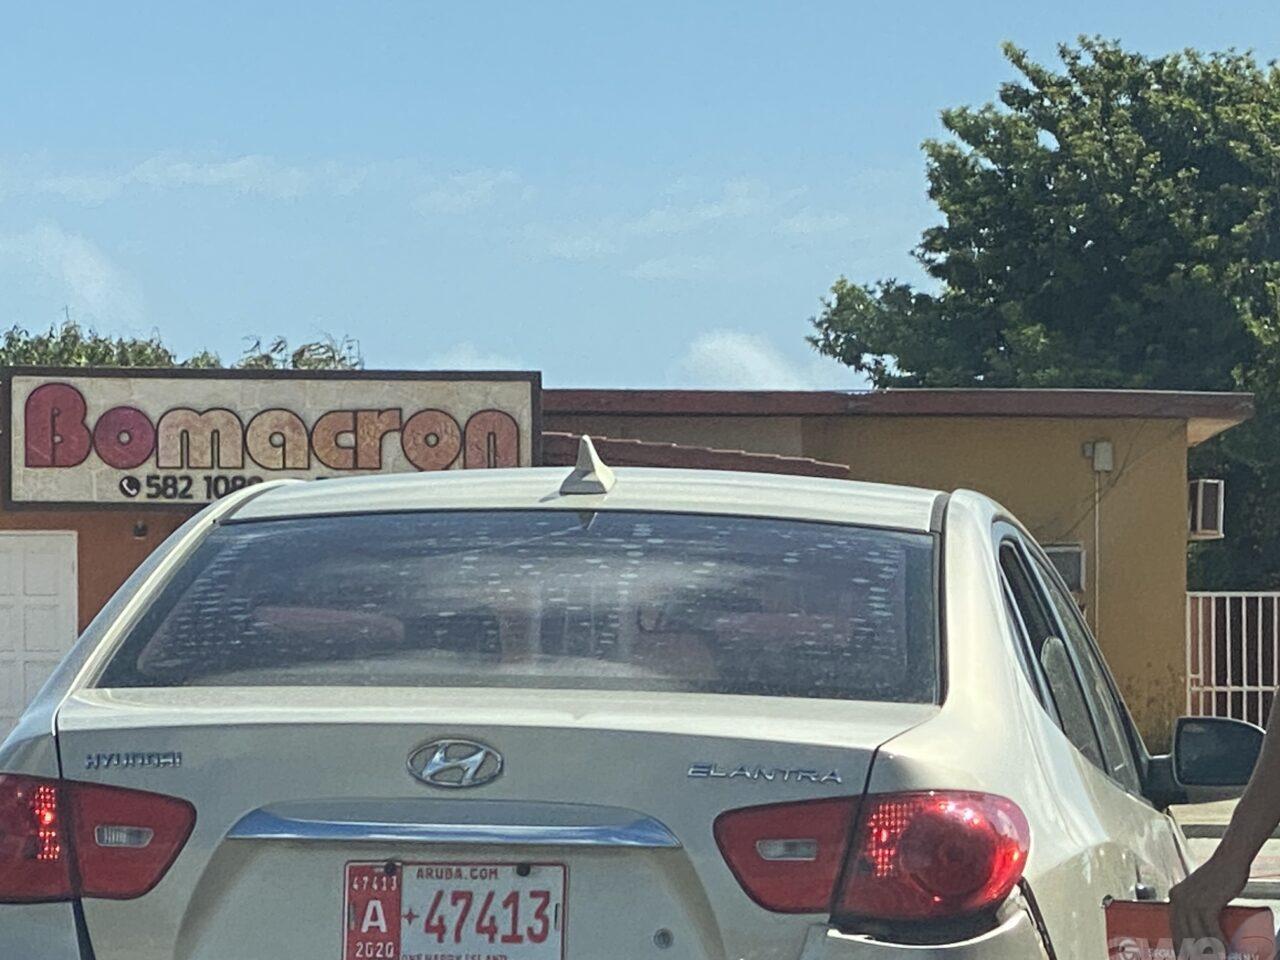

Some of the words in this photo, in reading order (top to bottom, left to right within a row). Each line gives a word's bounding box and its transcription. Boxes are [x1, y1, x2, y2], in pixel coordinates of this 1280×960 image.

[25, 382, 519, 470] Bomacron
[145, 475, 193, 499] 582
[203, 475, 264, 499] 108
[86, 752, 182, 769] HYUNDAI
[687, 763, 842, 784] ELANTRA
[352, 875, 397, 892] 47413
[416, 867, 499, 881] ARUBA.COM
[361, 899, 388, 934] A
[423, 890, 551, 944] 47413
[355, 941, 395, 959] 2020
